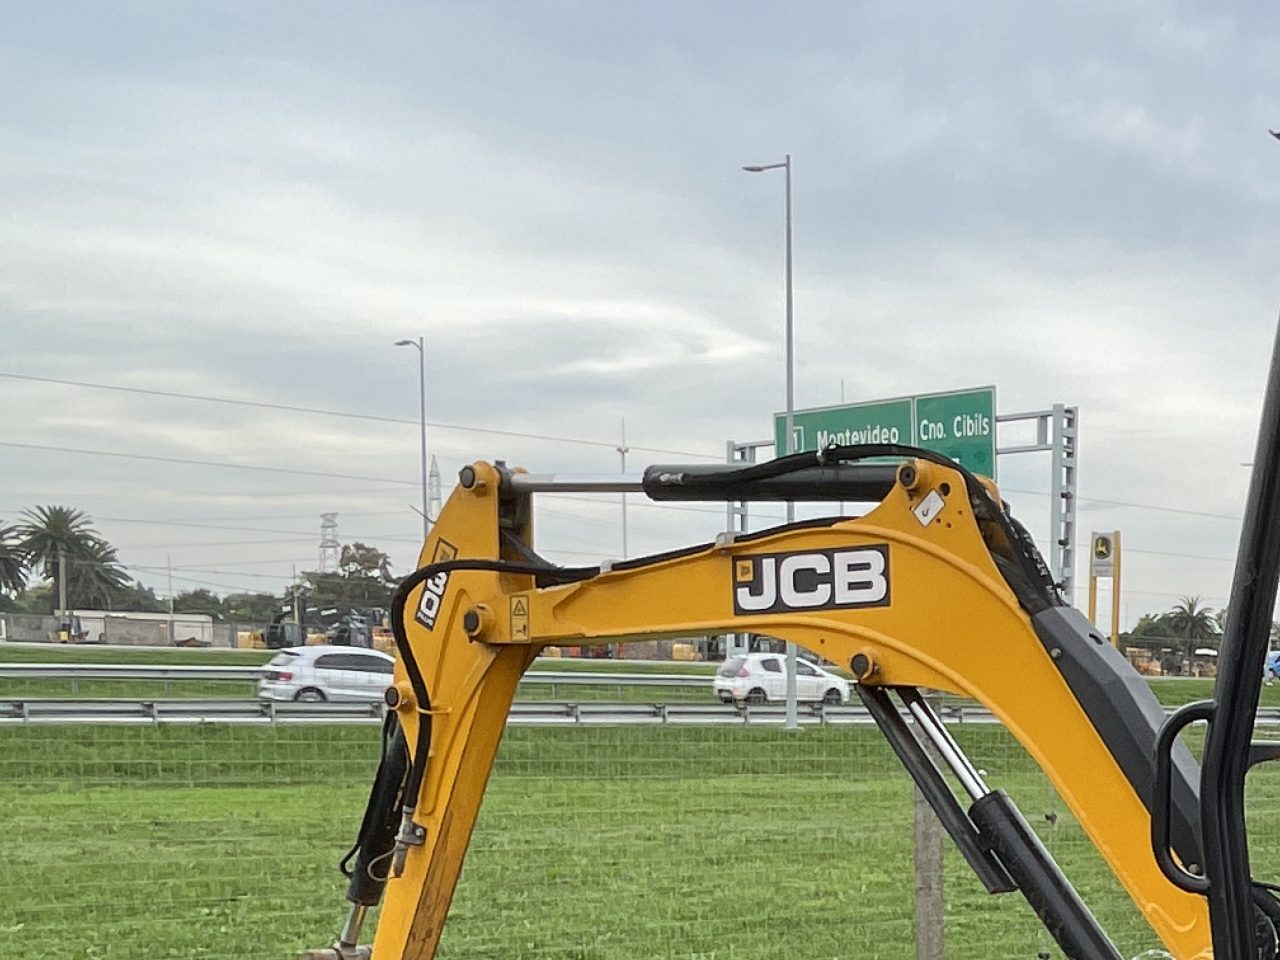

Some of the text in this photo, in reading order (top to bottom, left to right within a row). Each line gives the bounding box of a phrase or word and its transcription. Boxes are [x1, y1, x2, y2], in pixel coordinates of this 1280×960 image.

[816, 425, 899, 450] Montevideo
[920, 412, 989, 440] Cno. Cibils
[736, 550, 887, 611] JCB
